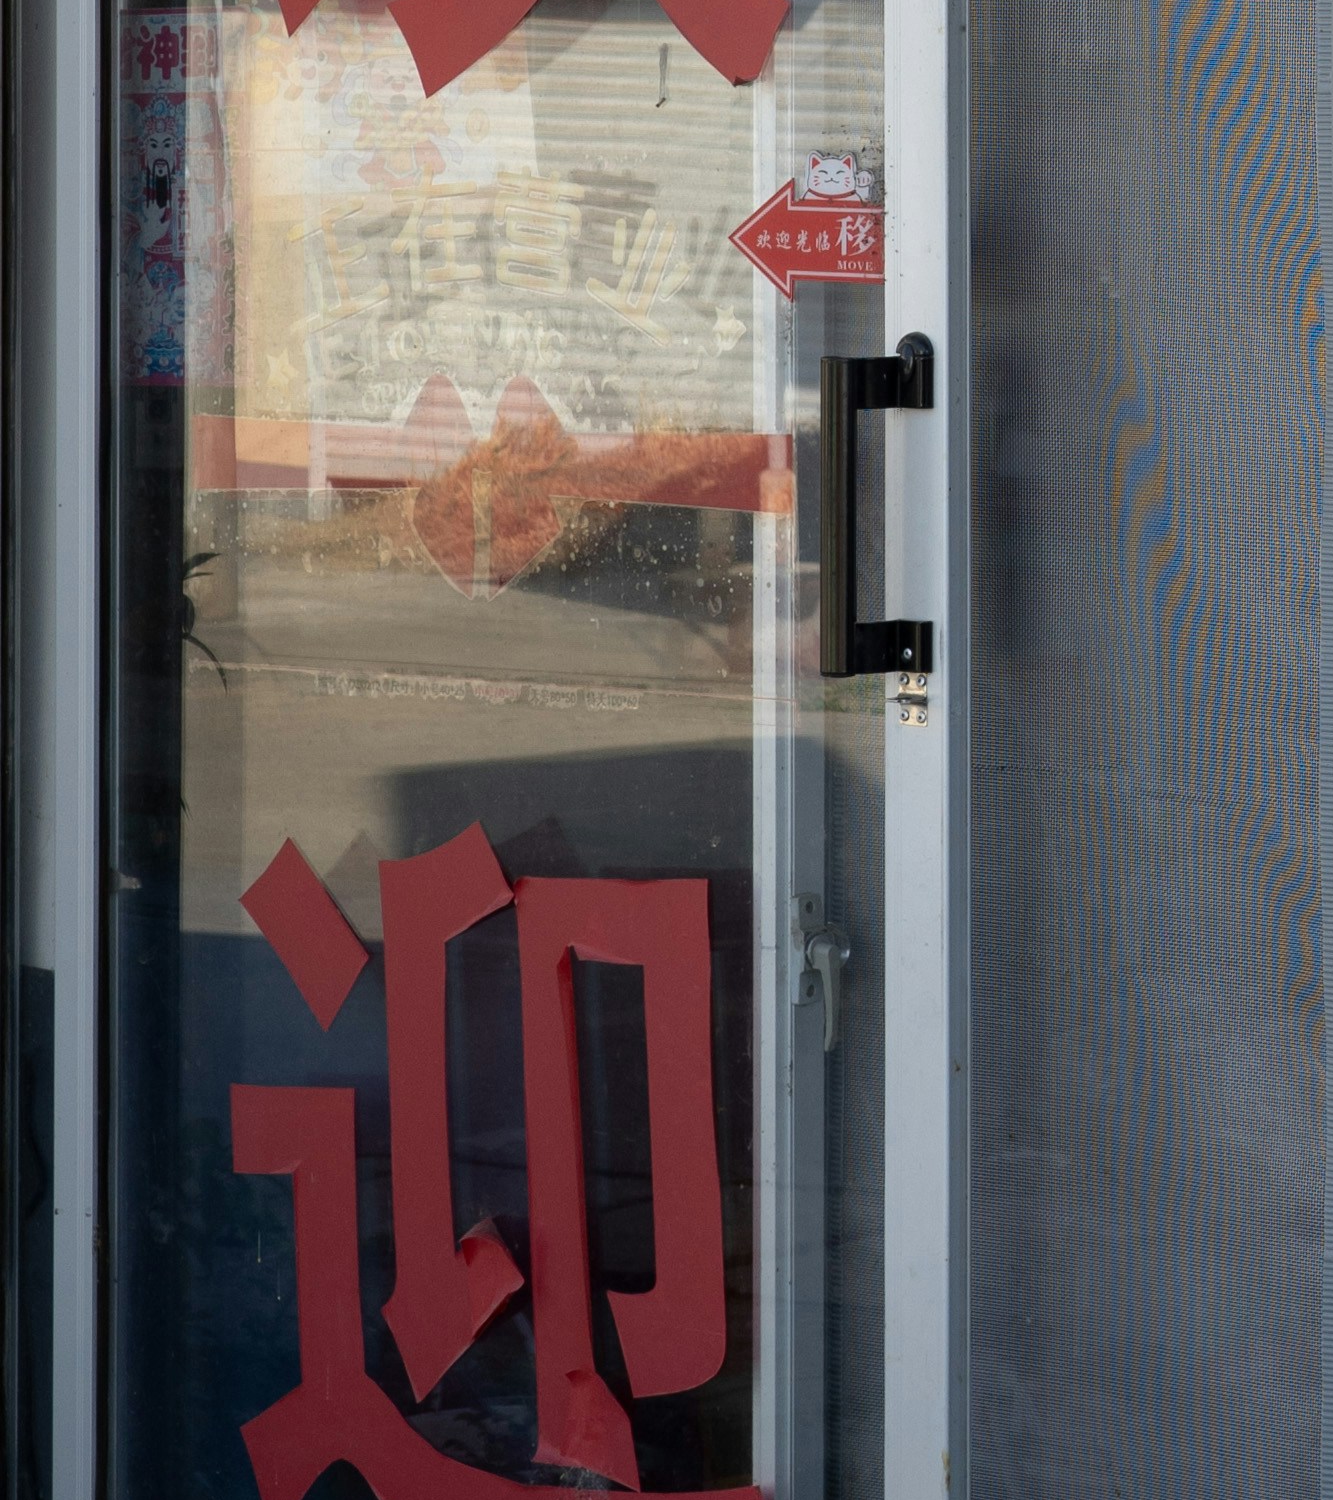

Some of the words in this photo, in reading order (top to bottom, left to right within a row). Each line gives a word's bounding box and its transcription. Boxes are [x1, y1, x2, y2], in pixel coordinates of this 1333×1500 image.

[287, 164, 695, 347] 正在营业
[755, 229, 831, 253] 欢迎光临
[835, 215, 877, 257] 移
[837, 260, 874, 272] MOVE
